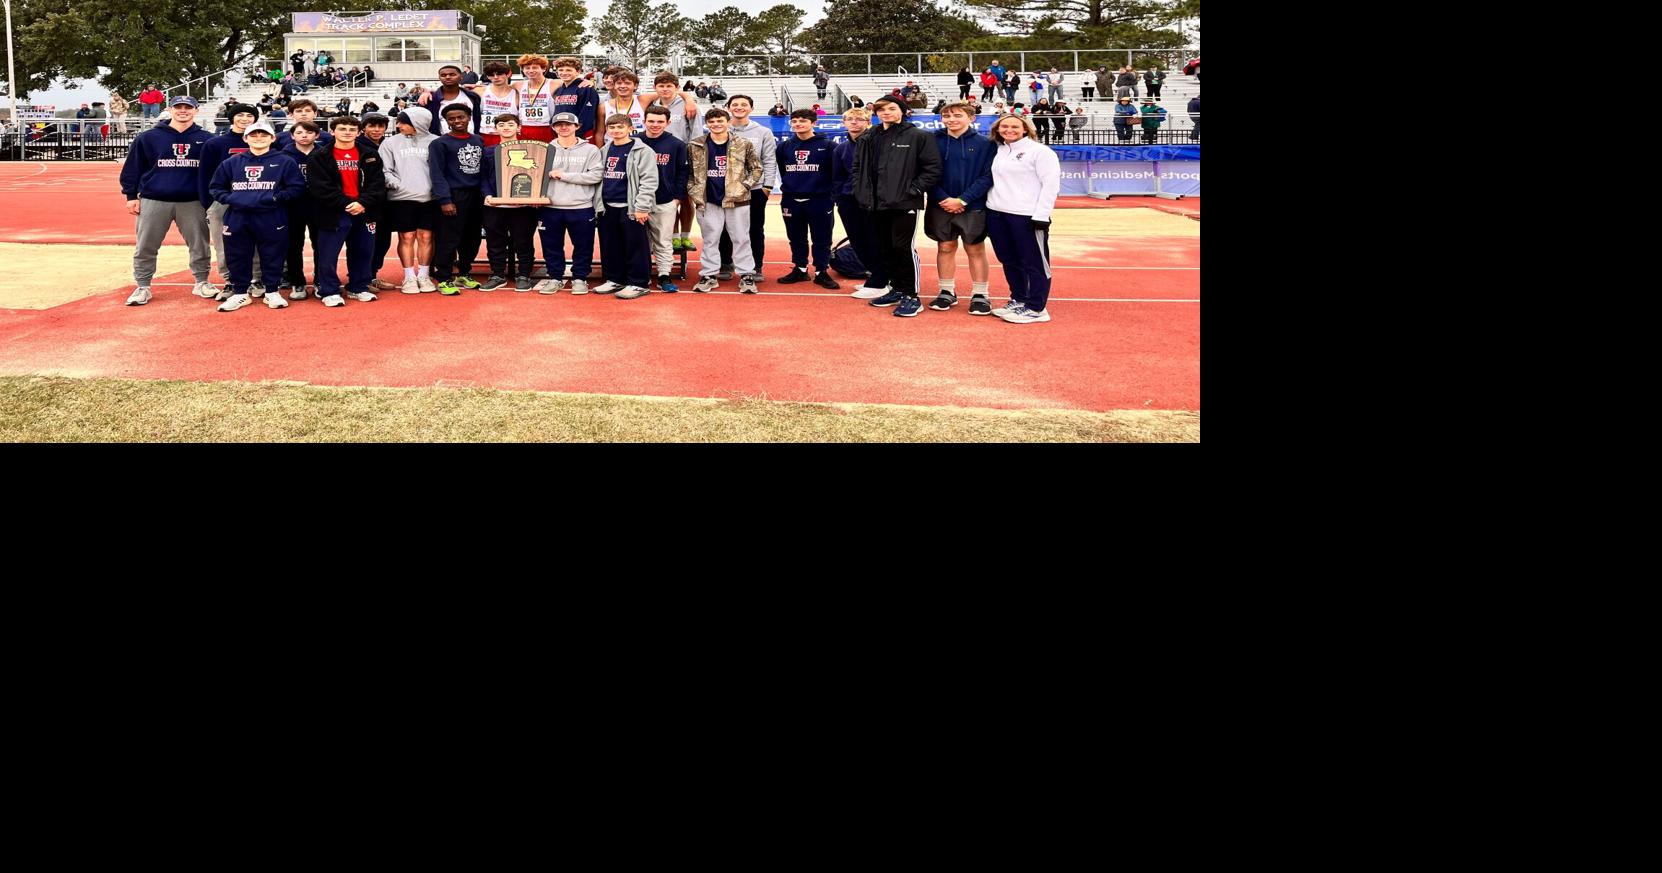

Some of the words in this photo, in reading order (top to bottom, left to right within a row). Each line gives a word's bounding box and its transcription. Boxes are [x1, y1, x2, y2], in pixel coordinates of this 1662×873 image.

[322, 15, 371, 23] WALTER
[391, 13, 428, 22] LEDET
[326, 22, 364, 30] TRACK
[368, 21, 424, 29] COMPLEX
[501, 139, 519, 148] STATE
[519, 139, 549, 148] CHAMPION
[157, 159, 175, 167] CROSS
[176, 159, 200, 167] COUNTRY
[797, 164, 819, 172] COUNTRY
[248, 181, 275, 190] COUNTRY
